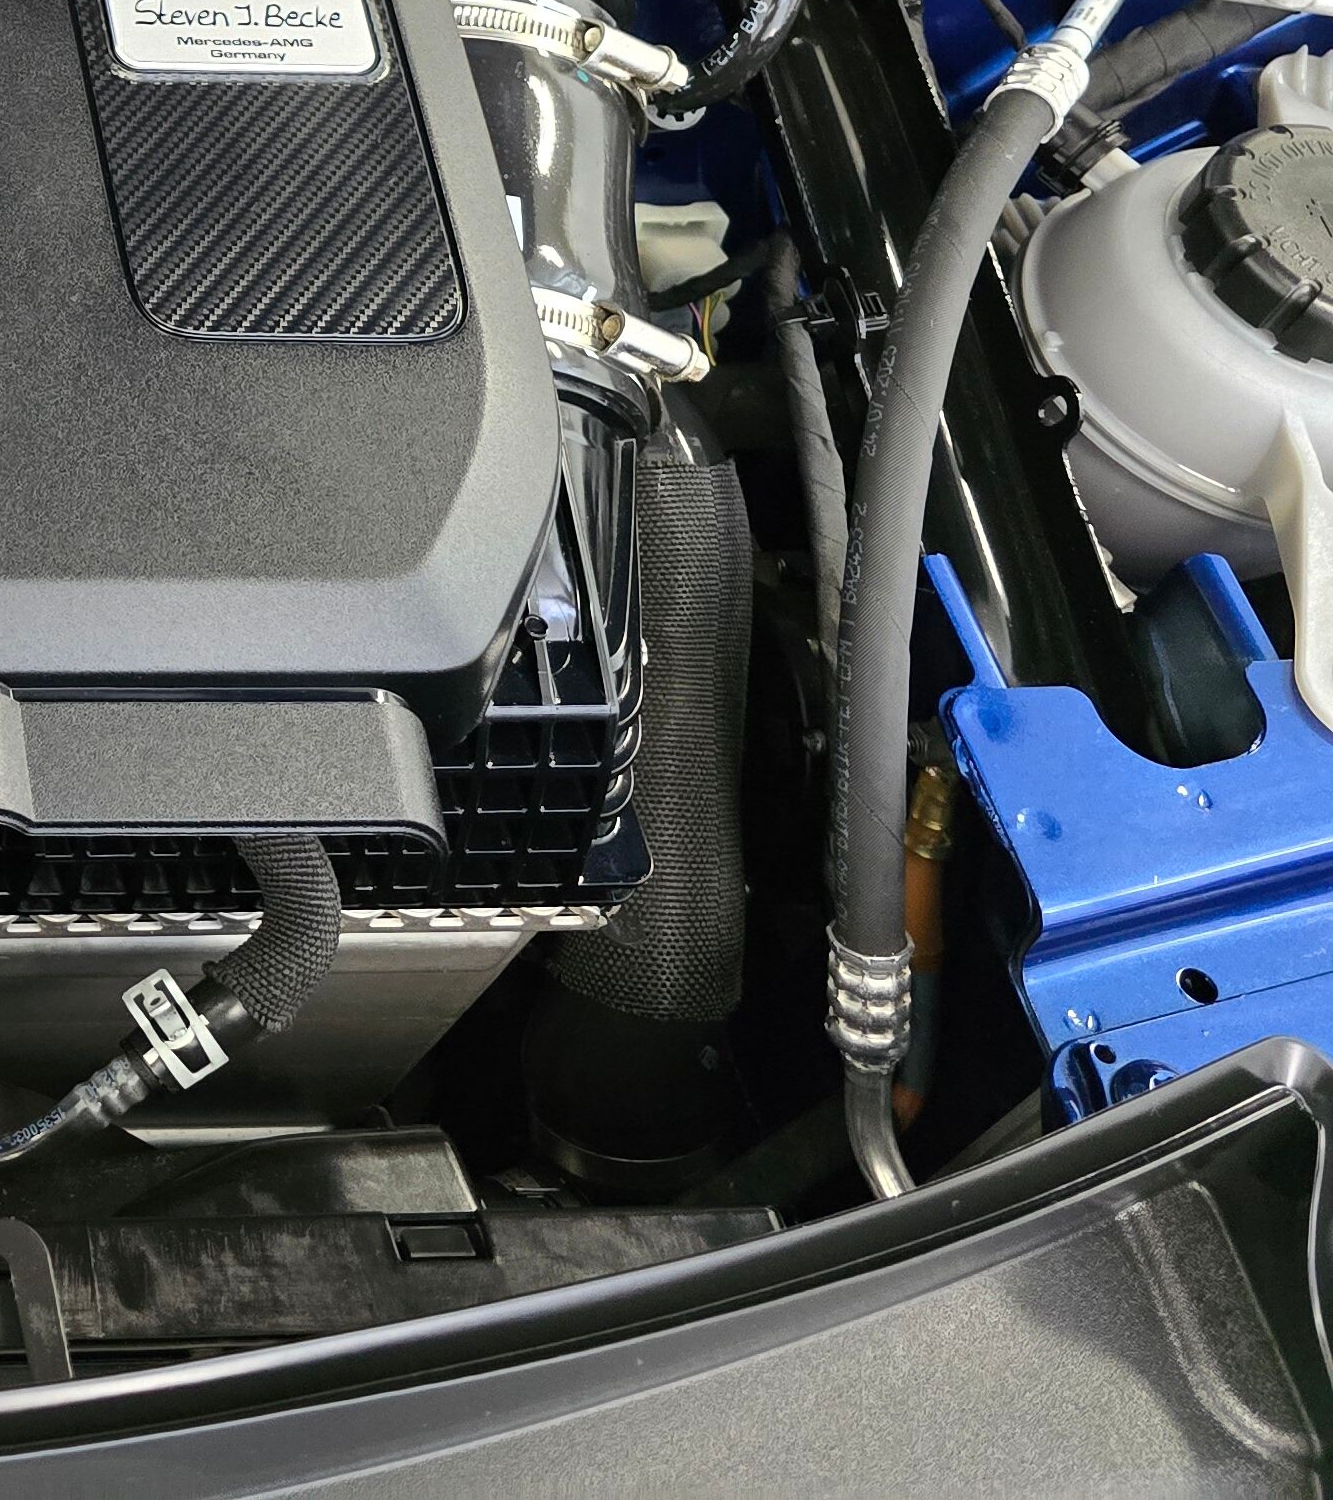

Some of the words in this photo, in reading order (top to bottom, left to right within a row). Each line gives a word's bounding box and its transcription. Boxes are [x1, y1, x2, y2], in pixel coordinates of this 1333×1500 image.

[264, 4, 344, 28] Becke
[176, 36, 314, 48] Mercedes-AMG
[210, 49, 287, 61] Germany
